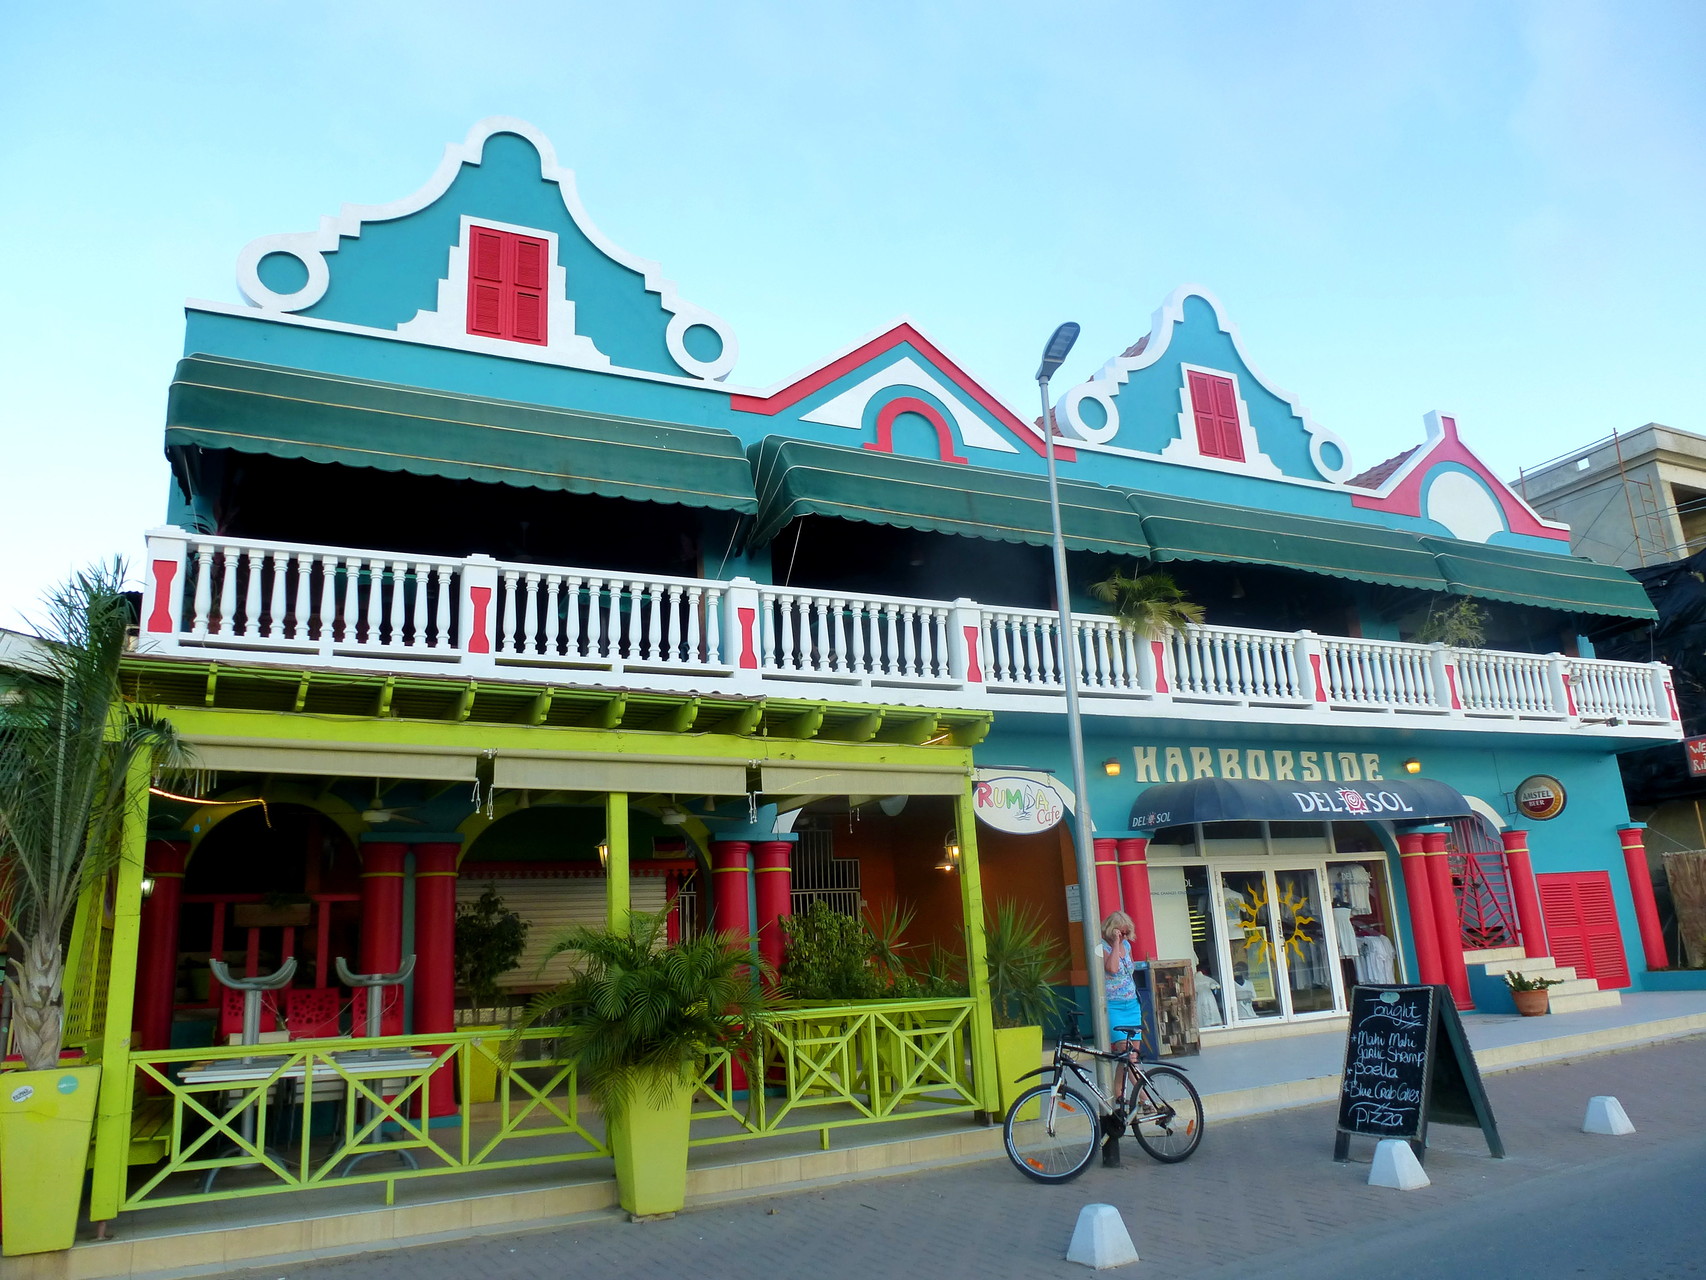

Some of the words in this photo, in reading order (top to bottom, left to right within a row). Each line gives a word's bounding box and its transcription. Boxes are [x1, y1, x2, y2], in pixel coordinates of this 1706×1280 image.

[1133, 746, 1384, 783] HARBORSIDE
[977, 782, 1049, 812] RUMBA
[1292, 791, 1343, 813] DEL
[1365, 791, 1414, 813] SOL
[1522, 790, 1552, 801] AMSTEL
[1528, 799, 1545, 807] BEER
[1036, 806, 1060, 826] Cafe
[1132, 816, 1147, 828] DEL
[1155, 811, 1171, 824] SOL
[1357, 1030, 1386, 1046] Mahi
[1388, 1031, 1417, 1048] Mahi
[1349, 1080, 1374, 1098] Blue
